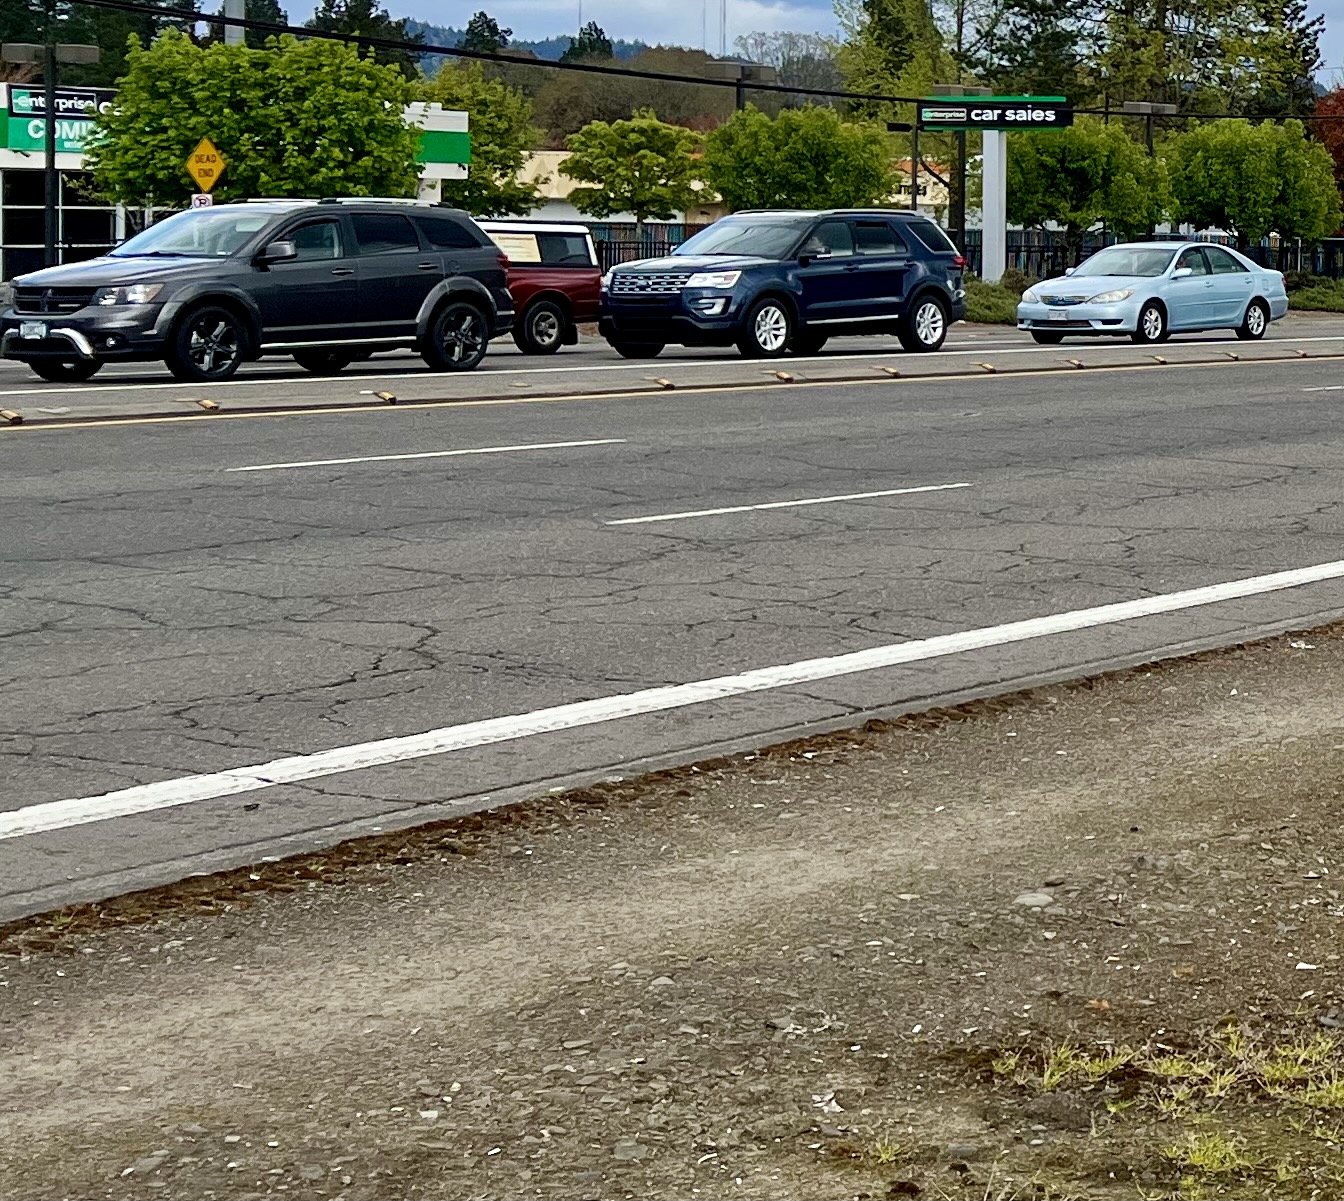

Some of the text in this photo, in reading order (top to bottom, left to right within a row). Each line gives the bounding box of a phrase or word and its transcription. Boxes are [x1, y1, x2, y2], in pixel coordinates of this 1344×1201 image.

[970, 109, 1002, 121] car
[1004, 105, 1056, 121] sales
[195, 154, 217, 164] DEAD
[198, 168, 214, 178] END
